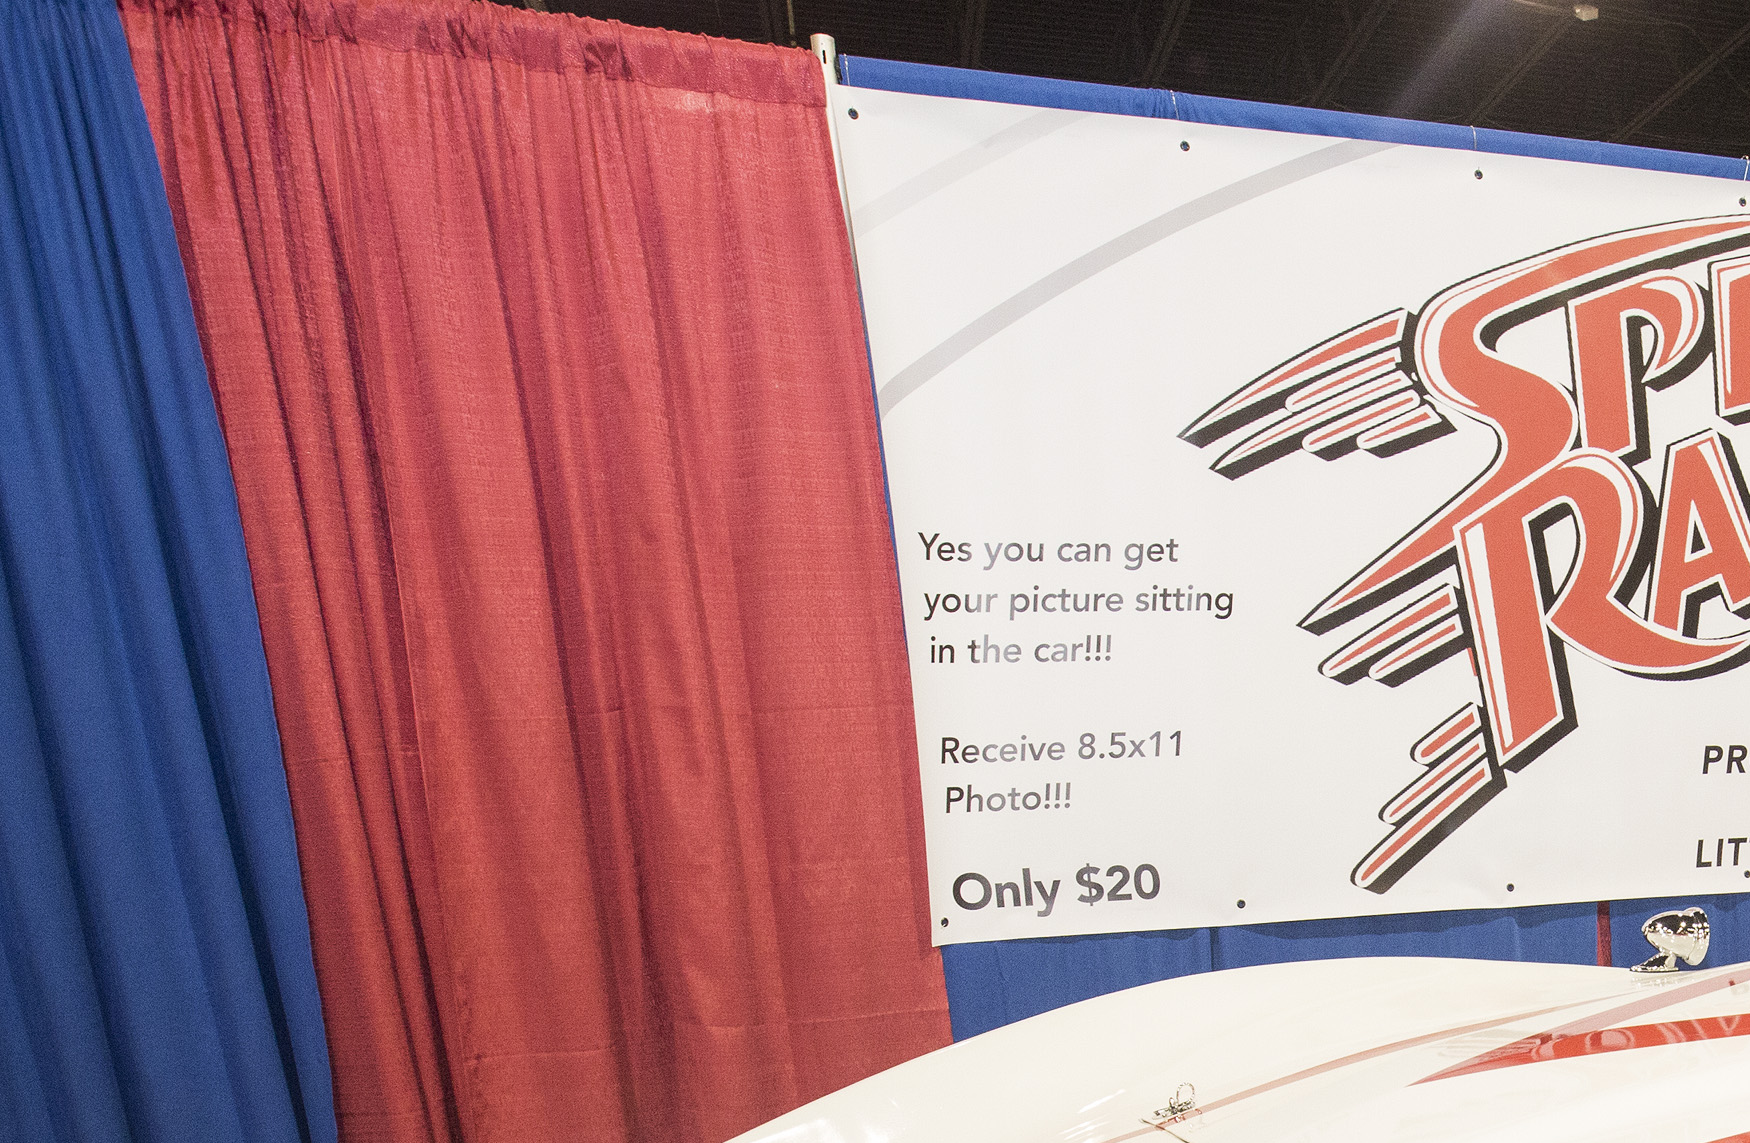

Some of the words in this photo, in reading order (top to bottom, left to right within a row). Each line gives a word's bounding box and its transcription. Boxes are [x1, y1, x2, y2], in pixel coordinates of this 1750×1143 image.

[917, 531, 973, 563] Yes
[983, 542, 1045, 571] you
[1057, 542, 1112, 563] can
[1124, 538, 1179, 571] get
[923, 592, 998, 622] your
[1009, 584, 1124, 621] picture
[1135, 584, 1234, 620] sitting
[930, 636, 955, 664] in
[967, 634, 1022, 664] the
[1033, 634, 1112, 663] car!!!
[940, 736, 1066, 765] Receive
[1077, 730, 1182, 760] 8.5x11
[945, 782, 1072, 814] Photo!!!
[952, 867, 1062, 918] Only
[1075, 862, 1161, 907] $20
